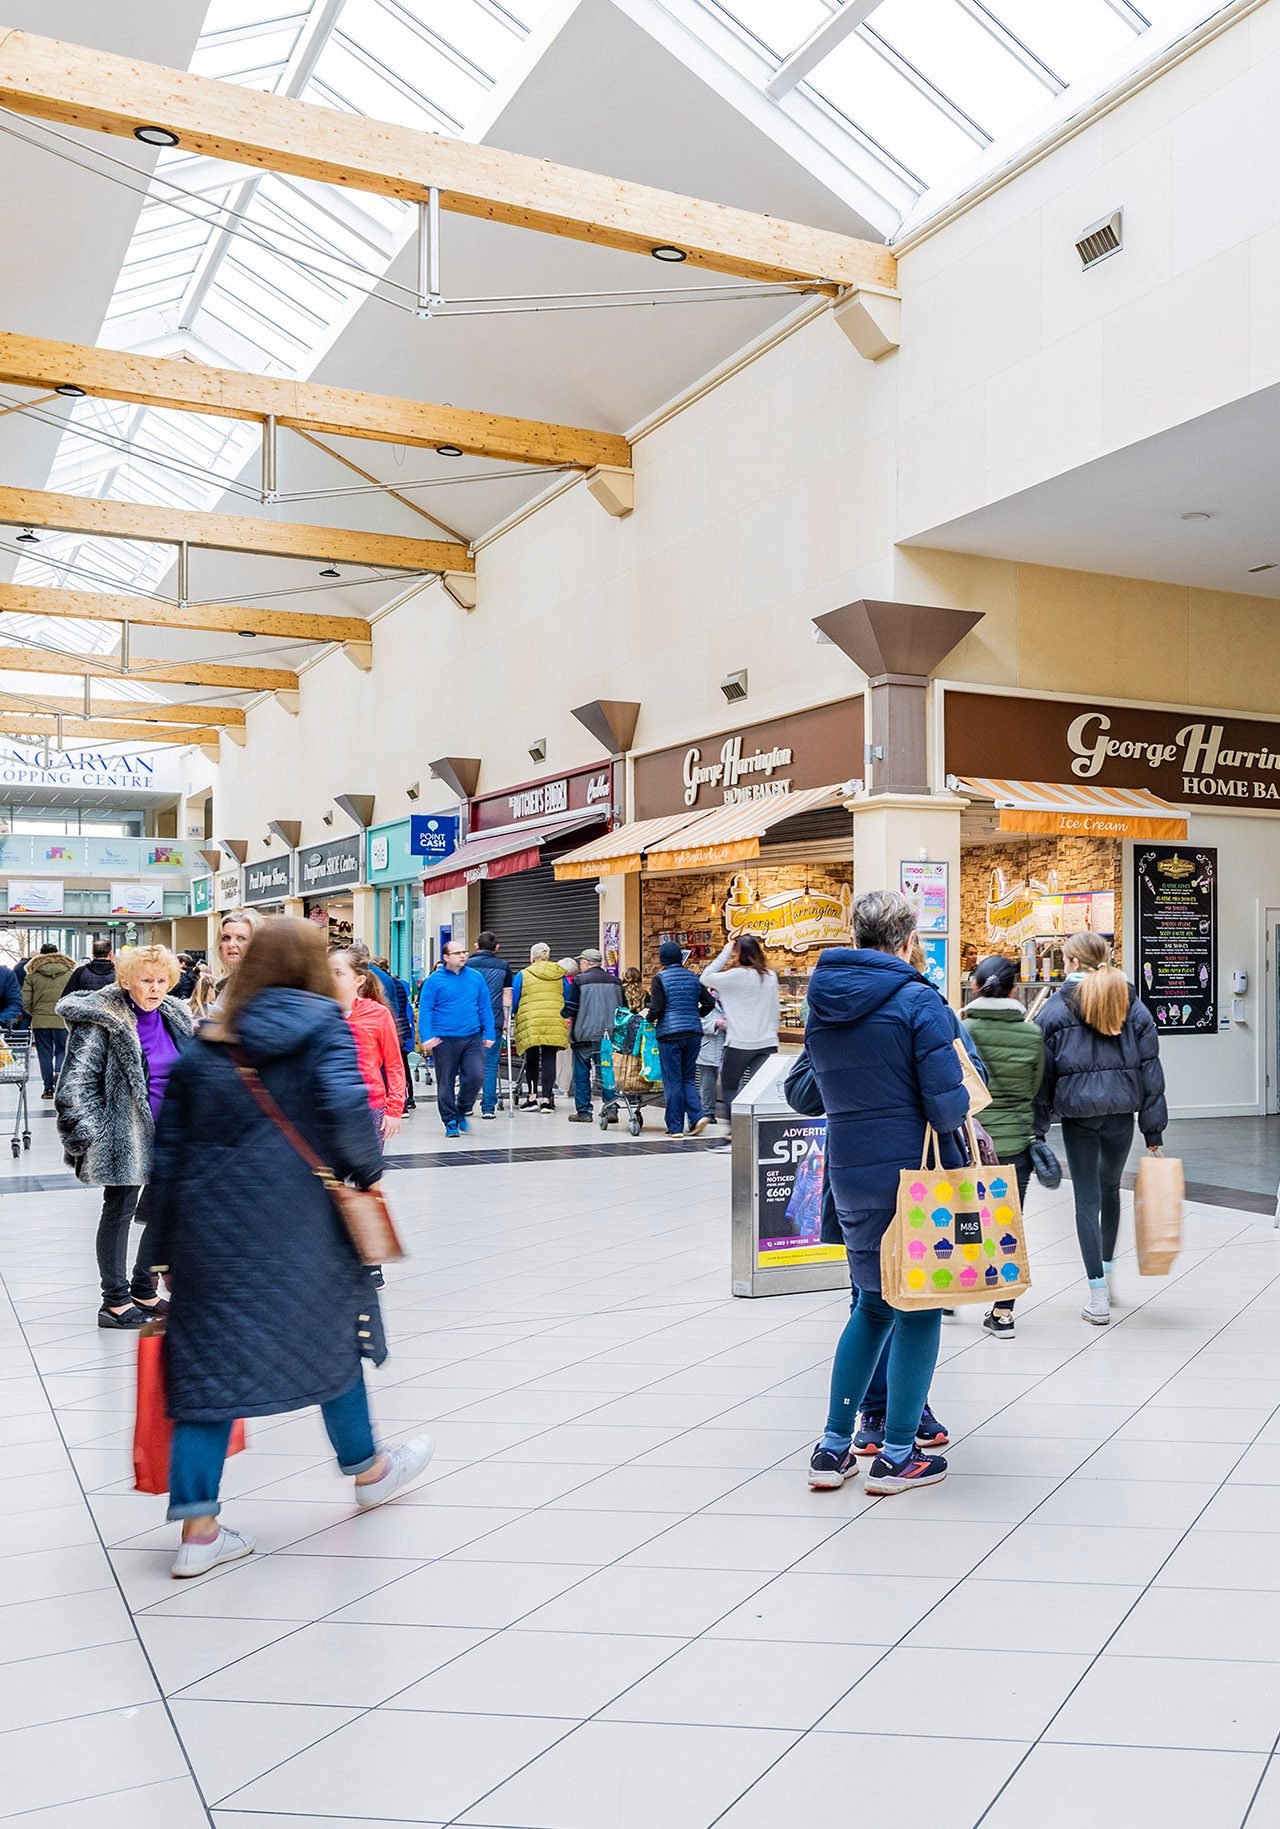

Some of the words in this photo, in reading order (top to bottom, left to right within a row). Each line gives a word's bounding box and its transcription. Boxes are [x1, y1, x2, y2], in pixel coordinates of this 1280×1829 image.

[1066, 712, 1177, 778] George
[683, 748, 723, 806] George
[720, 736, 792, 786] Harrington
[82, 773, 153, 788] CENTRE
[1182, 777, 1248, 798] HOME
[752, 779, 792, 800] BAKERY
[1059, 816, 1082, 829] Ice
[1083, 818, 1129, 832] Cream
[420, 840, 446, 848] CASH
[758, 1139, 825, 1165] SPA
[766, 1175, 795, 1183] NOTICED
[766, 1187, 791, 1197] €600
[960, 1222, 979, 1231] M&S
